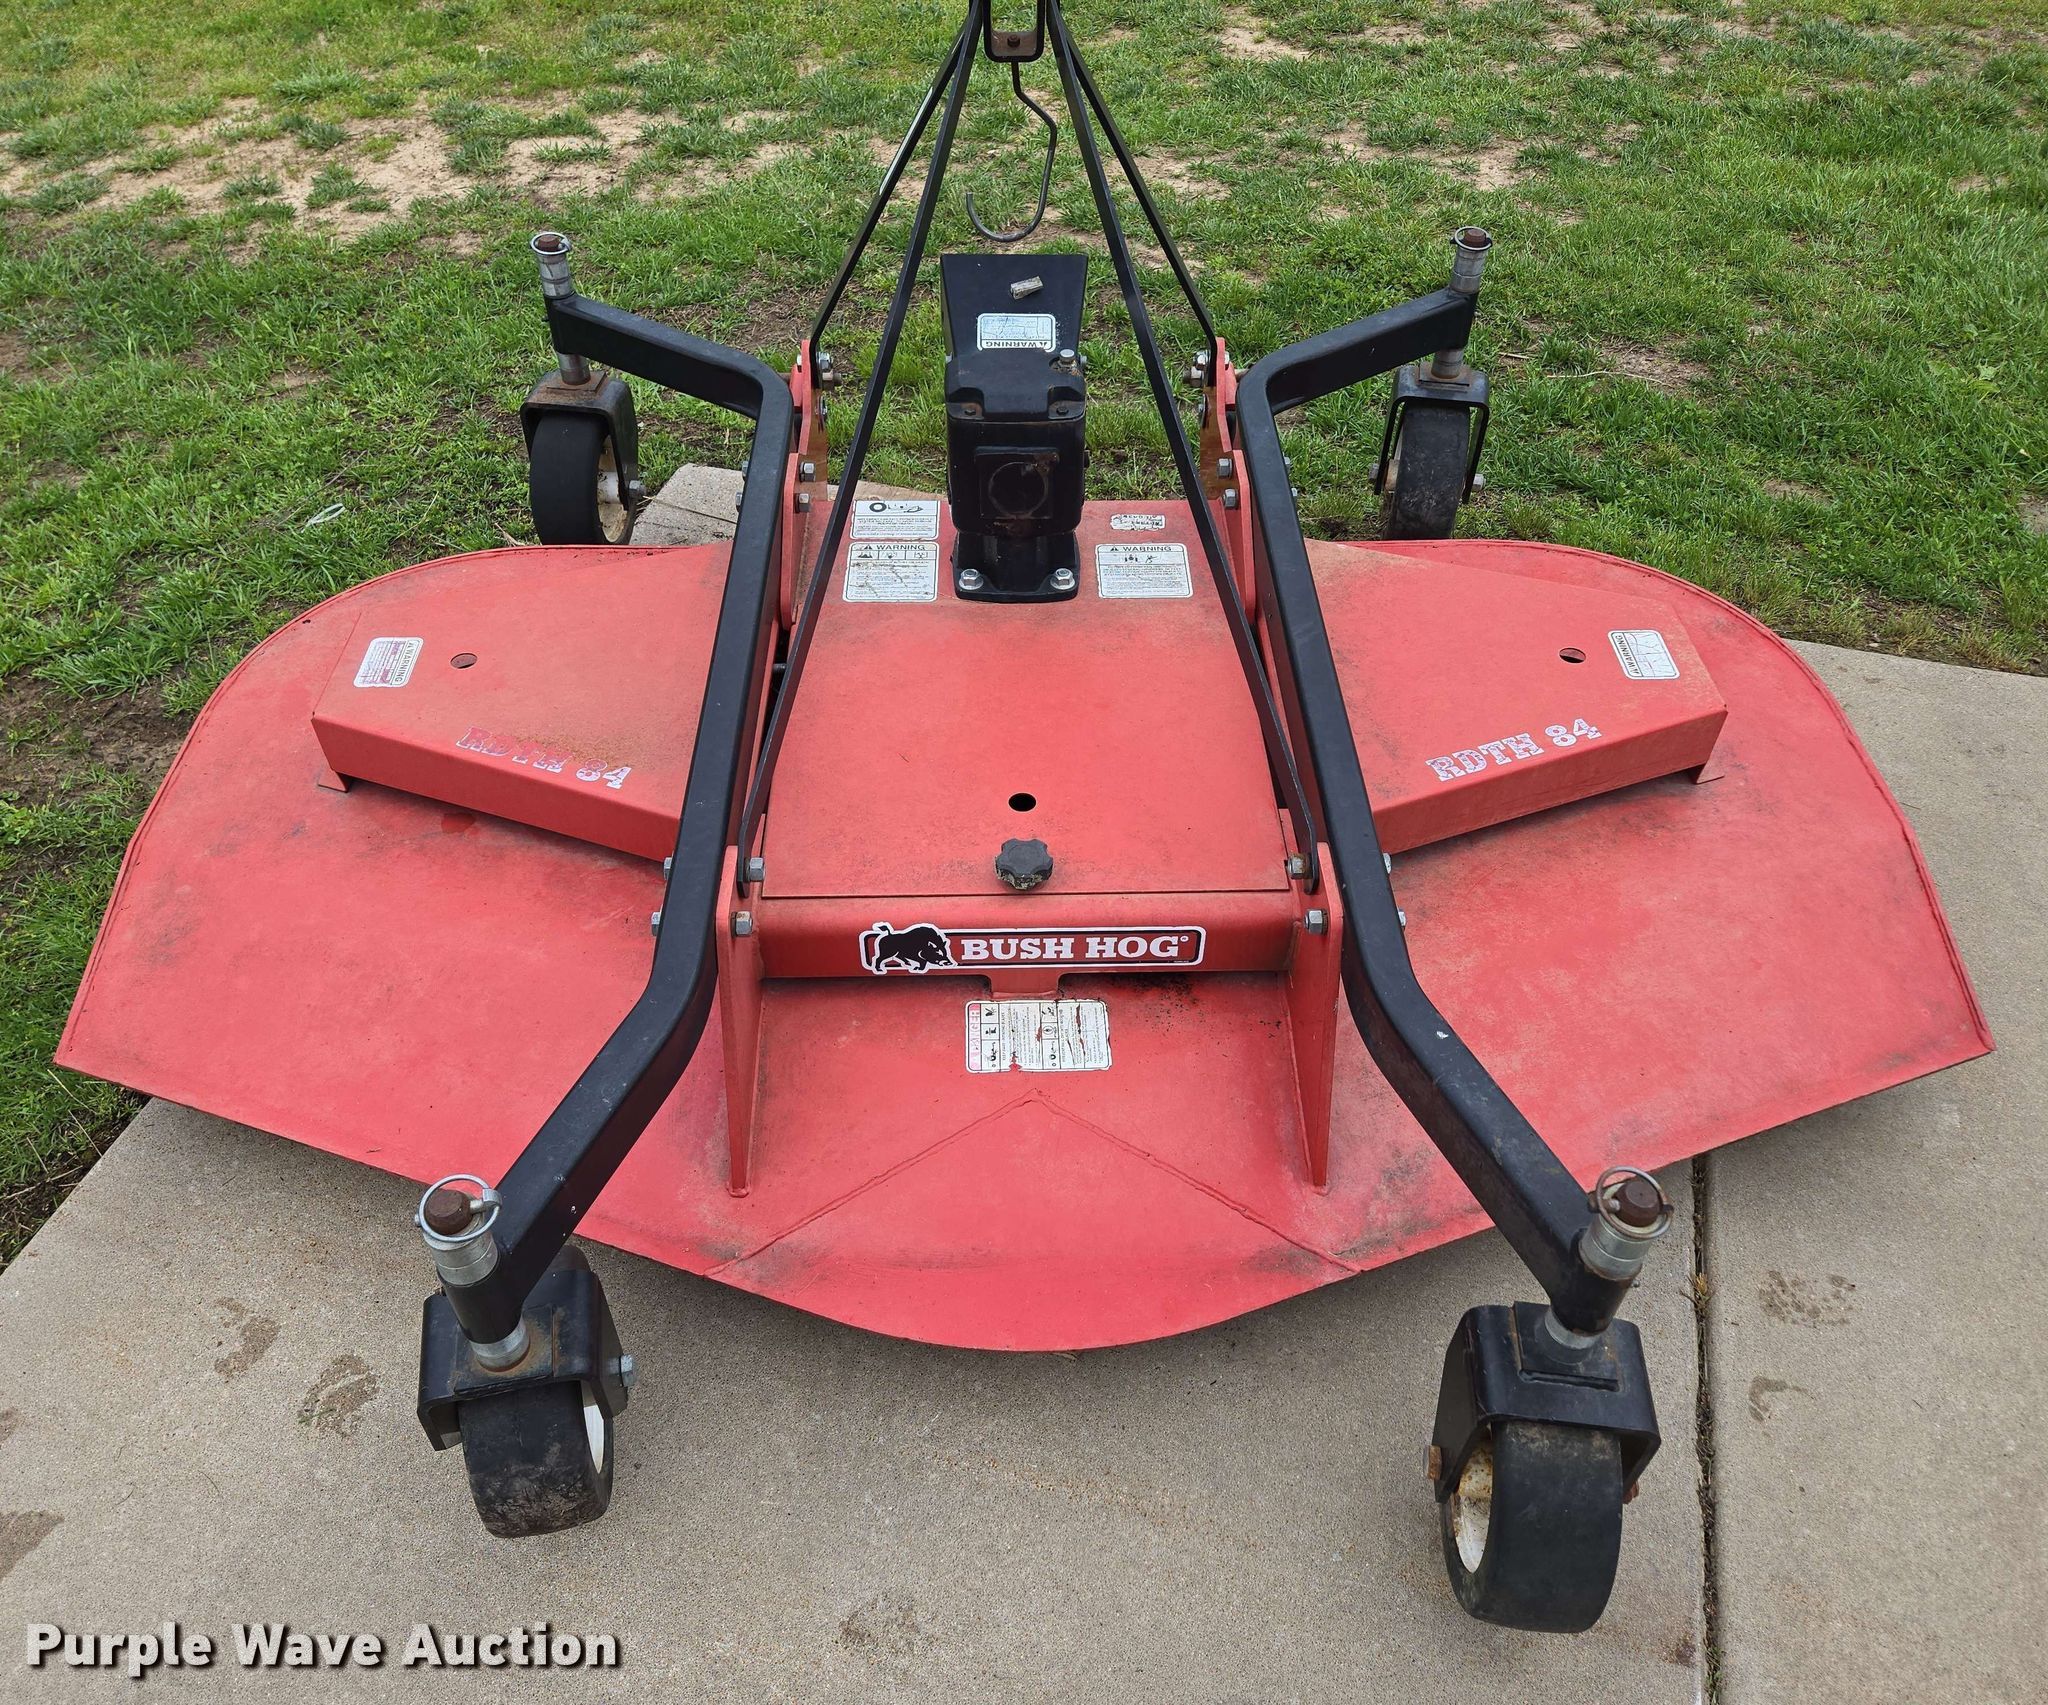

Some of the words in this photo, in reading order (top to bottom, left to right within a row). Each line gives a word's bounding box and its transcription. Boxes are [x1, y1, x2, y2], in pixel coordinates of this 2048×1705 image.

[395, 648, 415, 682] WARNING
[1615, 635, 1636, 668] WARNING
[1425, 733, 1544, 782] RDTH
[1545, 718, 1602, 747] 84
[576, 758, 632, 789] 84
[961, 938, 1073, 960] BUSH
